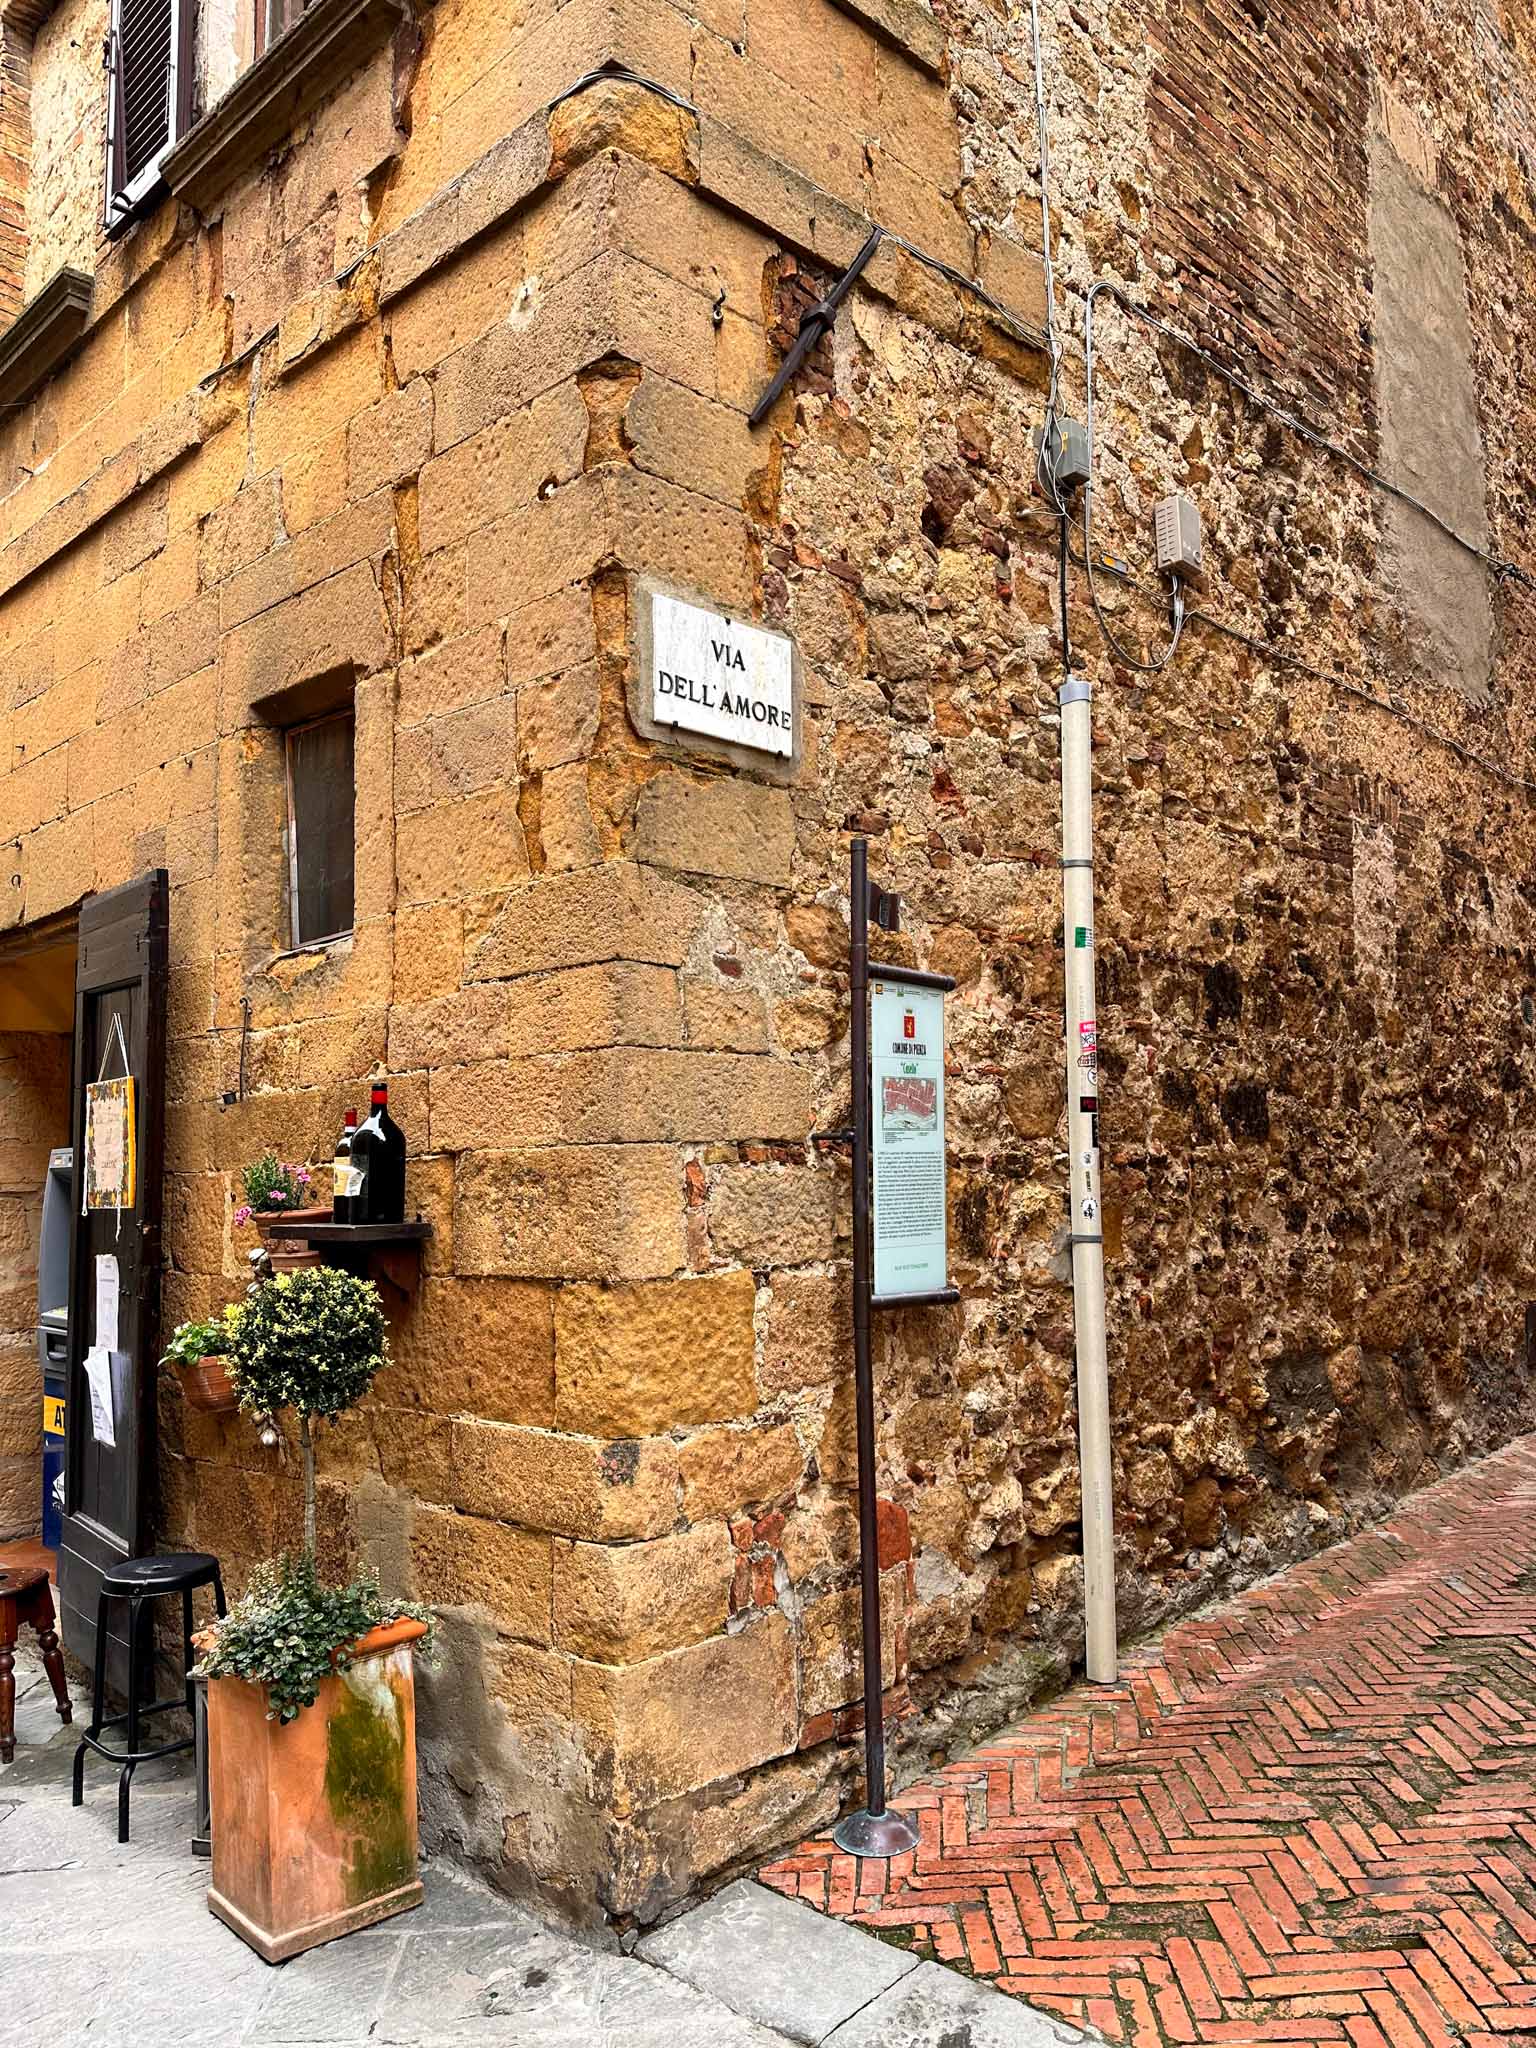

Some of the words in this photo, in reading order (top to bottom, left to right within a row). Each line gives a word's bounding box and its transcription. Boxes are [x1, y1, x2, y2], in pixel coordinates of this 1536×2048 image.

[711, 640, 746, 671] VIA
[658, 670, 792, 730] DELL'AMORE
[892, 1042, 908, 1055] COMUNE
